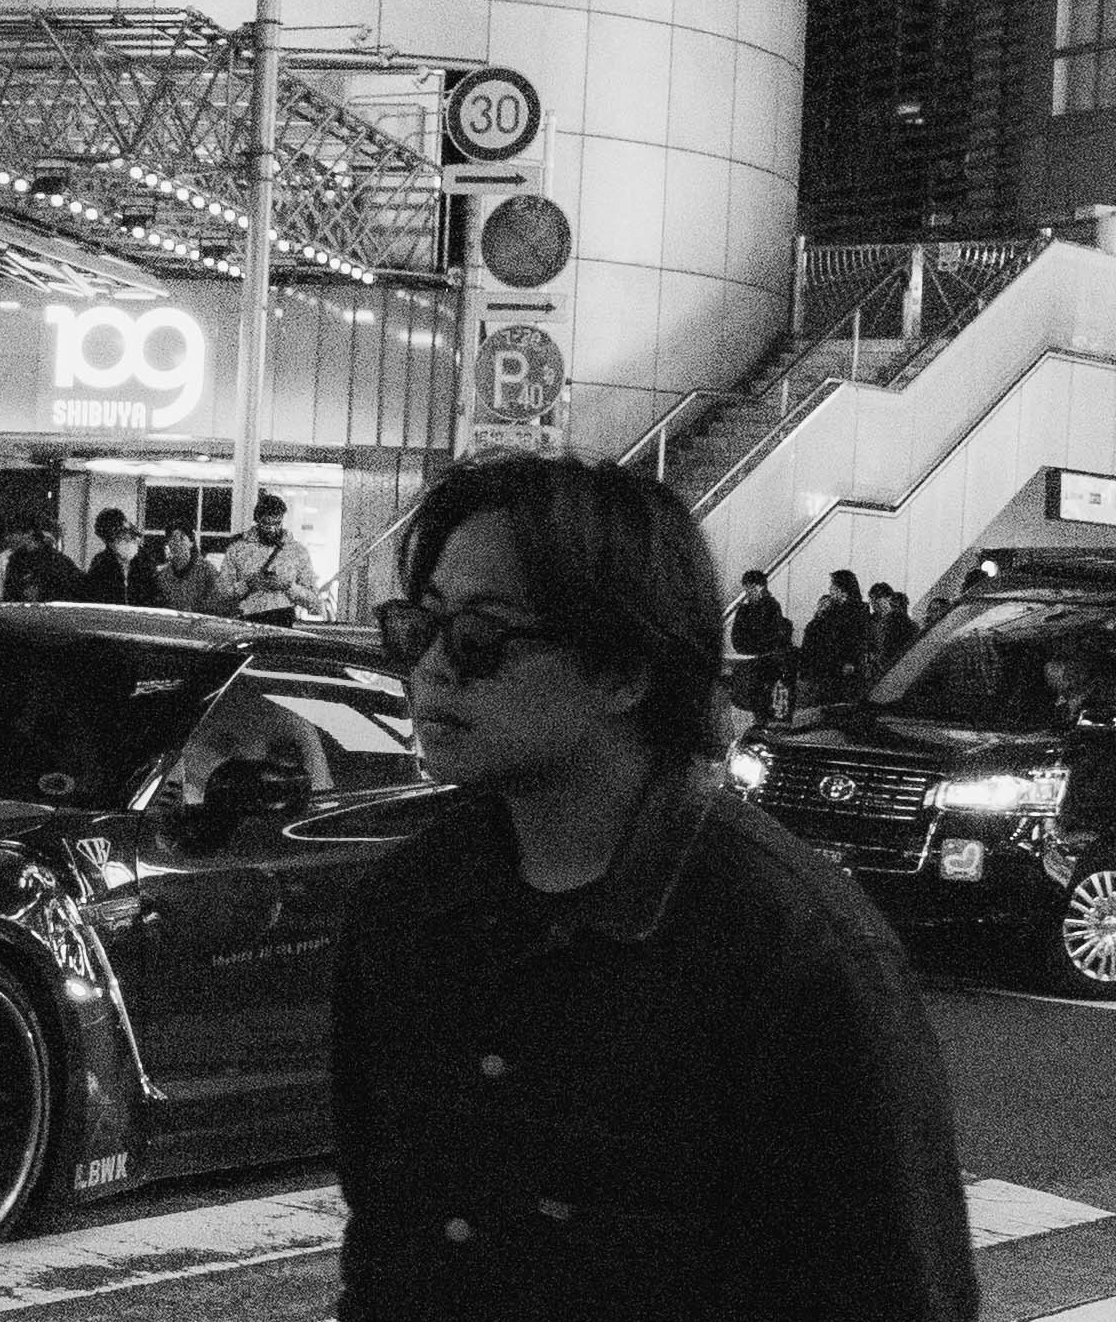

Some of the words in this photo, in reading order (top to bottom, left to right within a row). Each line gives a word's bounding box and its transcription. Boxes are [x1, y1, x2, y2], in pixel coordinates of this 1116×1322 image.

[470, 94, 521, 135] 30
[46, 303, 205, 430] 109
[493, 350, 530, 409] P
[52, 400, 147, 429] SHIBUYA
[74, 1151, 128, 1190] LBWK
